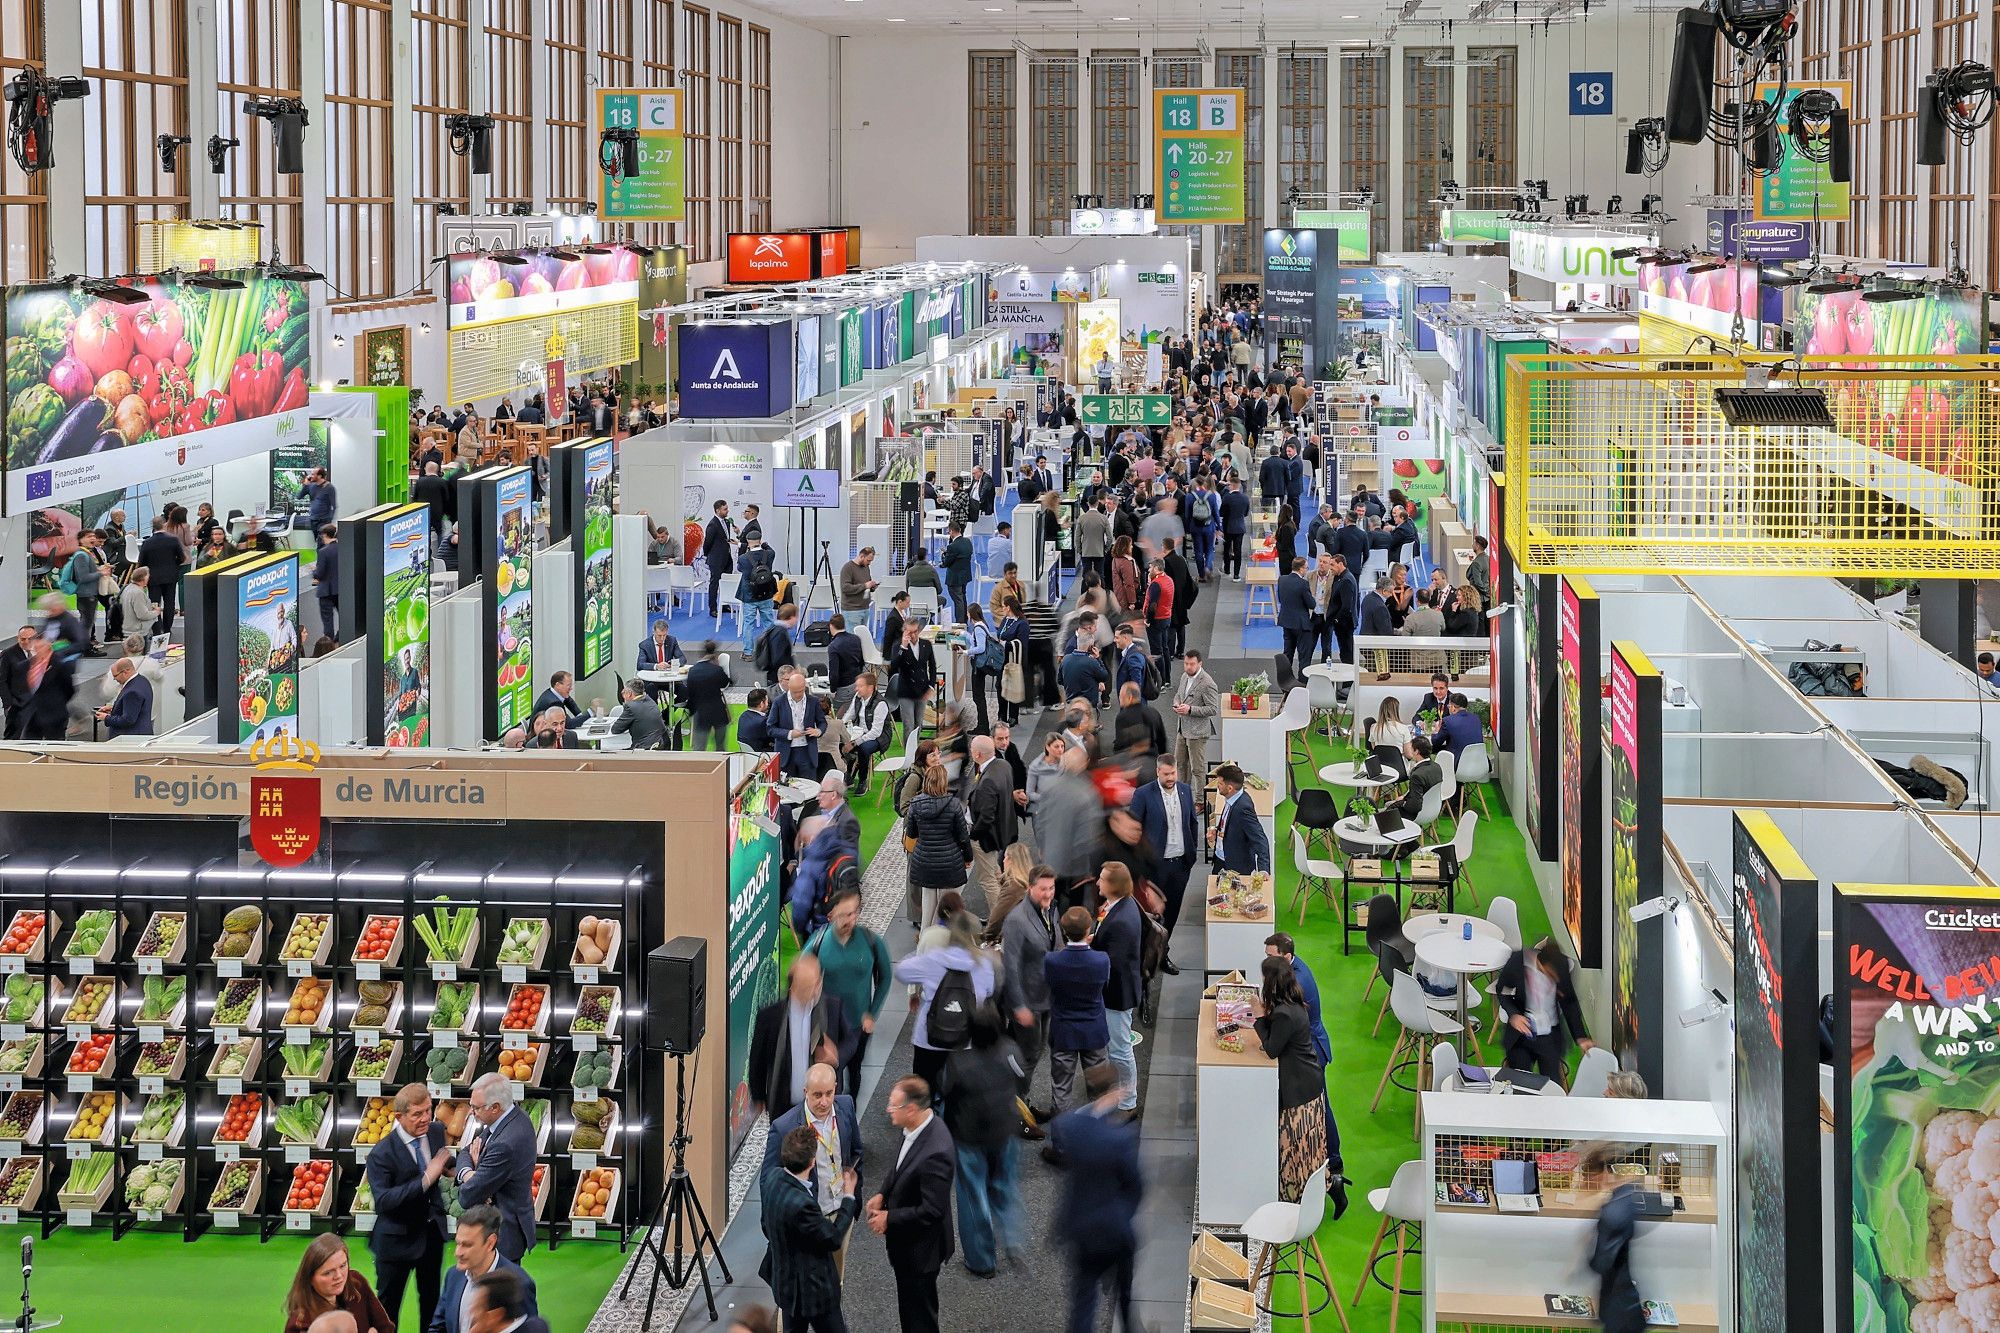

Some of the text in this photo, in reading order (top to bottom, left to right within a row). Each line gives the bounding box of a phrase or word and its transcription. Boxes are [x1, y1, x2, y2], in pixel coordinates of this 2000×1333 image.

[614, 97, 628, 105] Hall
[650, 97, 666, 105] Aisle
[1576, 82, 1605, 105] 18
[610, 110, 632, 126] 18
[650, 106, 664, 125] C
[1169, 110, 1191, 126] 18
[1212, 108, 1225, 126] B
[1188, 142, 1208, 150] Halls
[1188, 151, 1233, 165] 20-27
[1297, 220, 1367, 230] Extremadura
[750, 259, 788, 270] lapalma
[1268, 256, 1312, 266] CENTRO SUR
[652, 264, 678, 280] surexport
[1277, 289, 1296, 298] Strategic
[1002, 314, 1044, 323] MANCHA
[723, 380, 759, 389] Andalucía
[276, 414, 294, 438] info
[55, 464, 95, 480] Financiado por
[178, 470, 204, 484] sustainable
[62, 478, 77, 489] Unión
[78, 474, 101, 488] Europea
[161, 478, 212, 498] agriculture worldwide
[247, 564, 288, 593] proexport
[134, 774, 485, 806] Región de Murcia
[1924, 908, 2000, 928] Cricket
[1884, 1000, 1904, 1022] A
[1912, 994, 1992, 1038] WAY
[1934, 1040, 1995, 1056] AND TO
